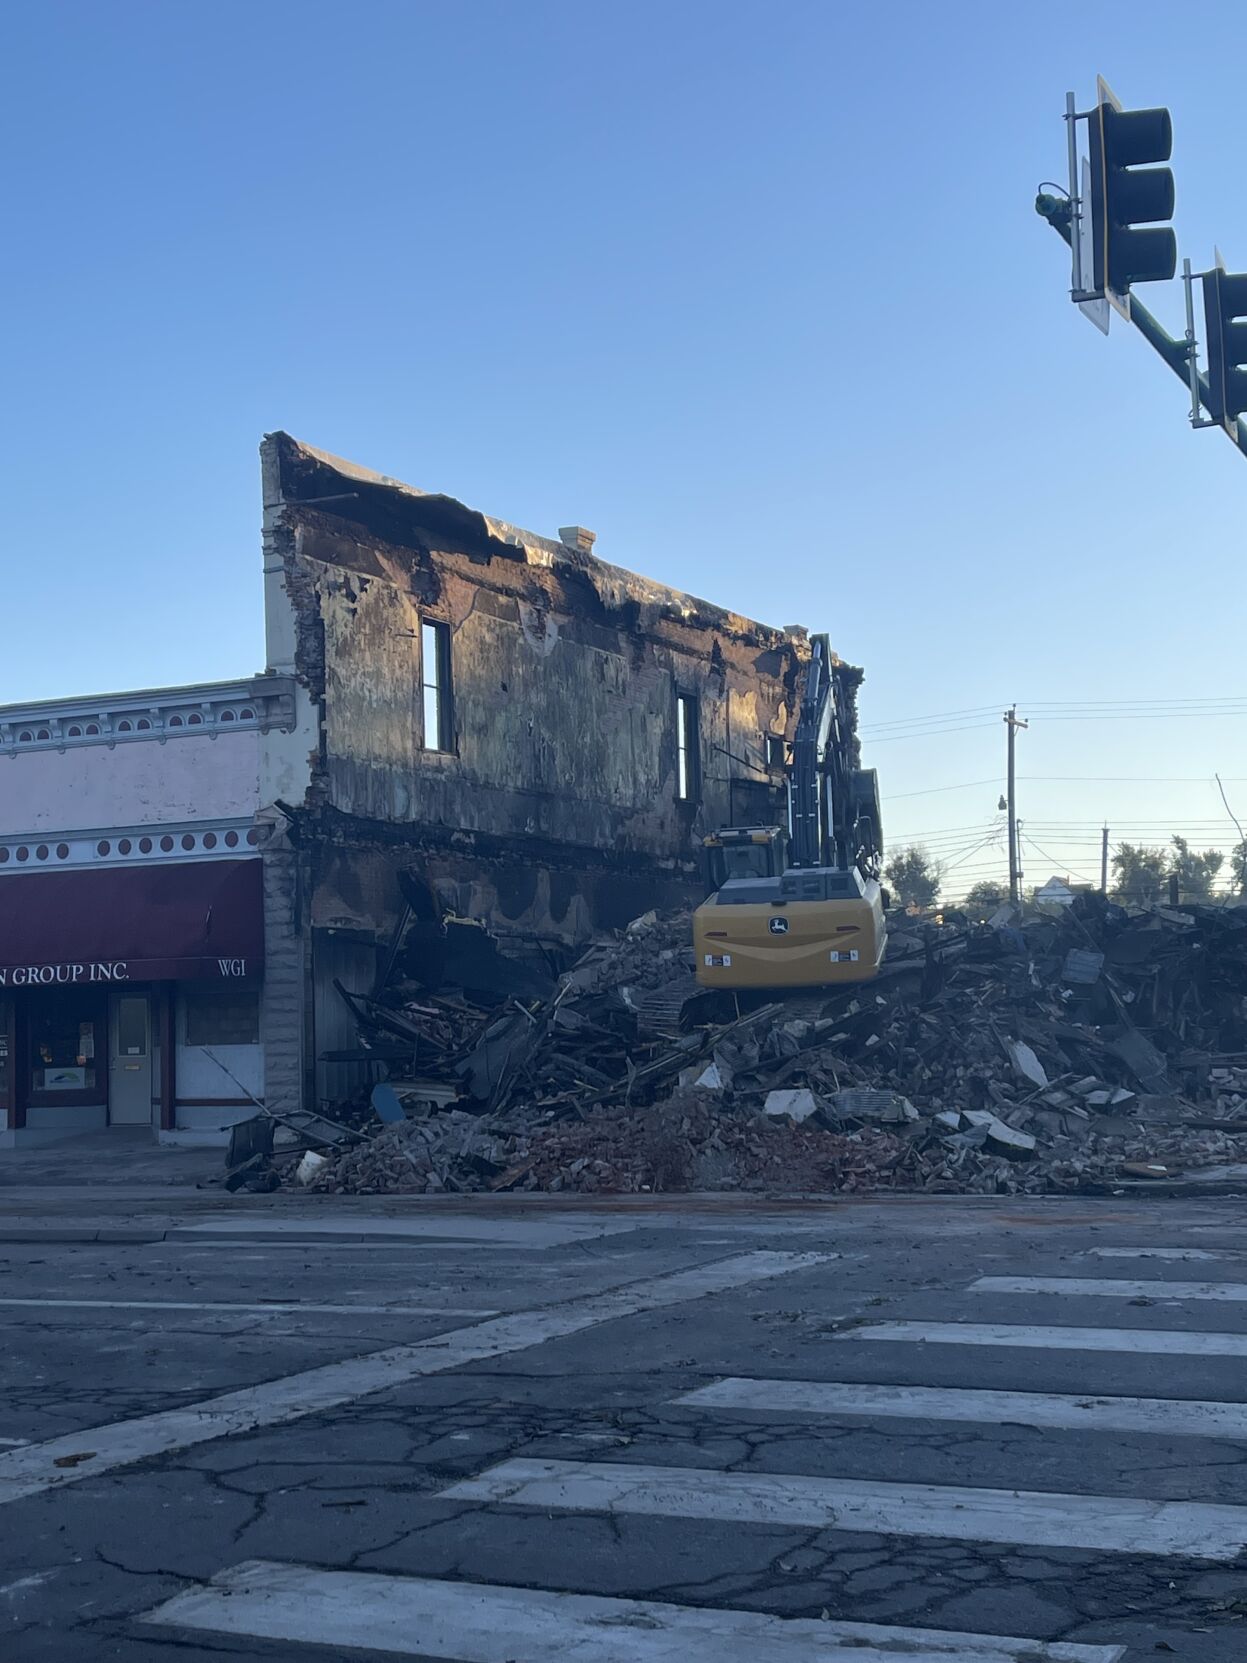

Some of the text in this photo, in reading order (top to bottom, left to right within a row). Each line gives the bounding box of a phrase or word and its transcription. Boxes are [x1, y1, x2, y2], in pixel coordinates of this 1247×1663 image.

[12, 965, 84, 985] GROUP
[89, 962, 130, 981] INC.
[218, 959, 246, 977] WGI
